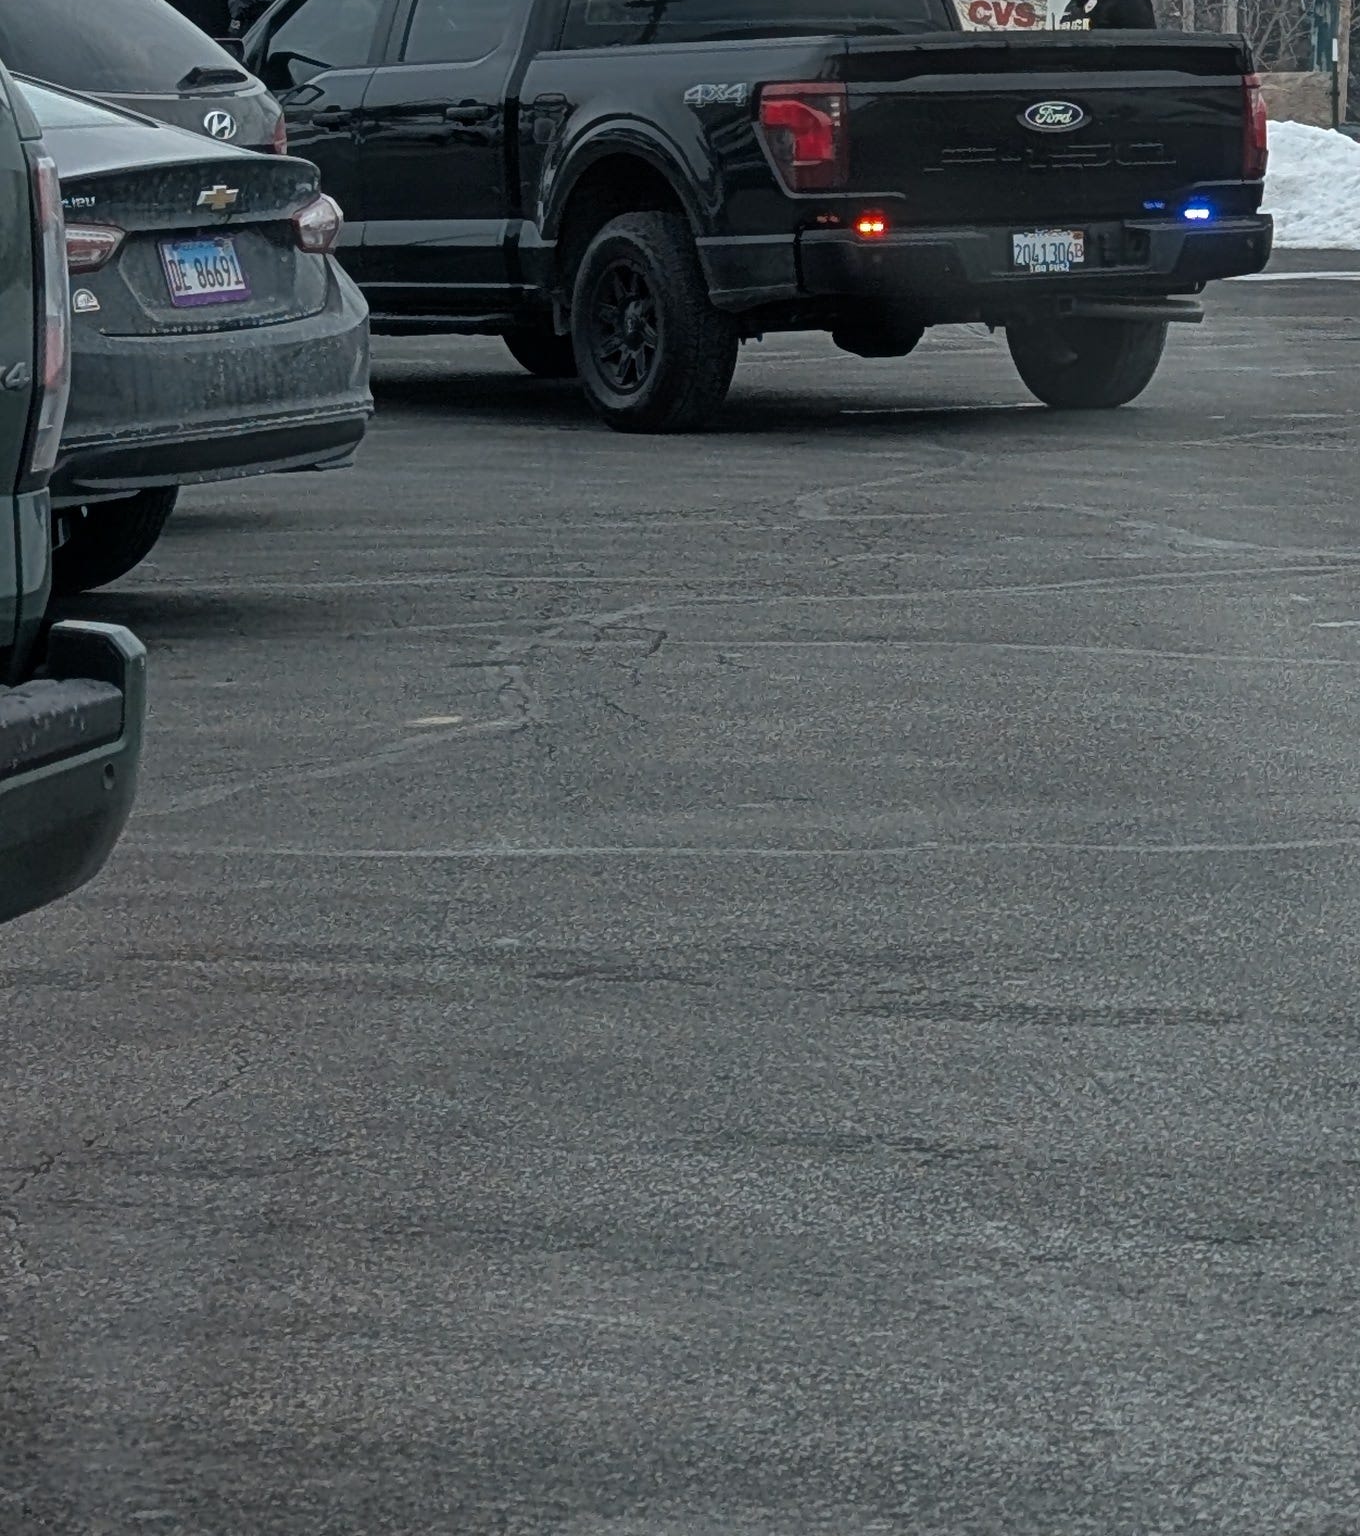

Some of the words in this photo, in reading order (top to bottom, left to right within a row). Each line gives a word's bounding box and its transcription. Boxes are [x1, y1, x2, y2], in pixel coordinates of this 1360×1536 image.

[968, 0, 1036, 28] CVS
[1035, 105, 1073, 124] Ford
[167, 259, 193, 292] DE
[193, 254, 243, 289] 86691
